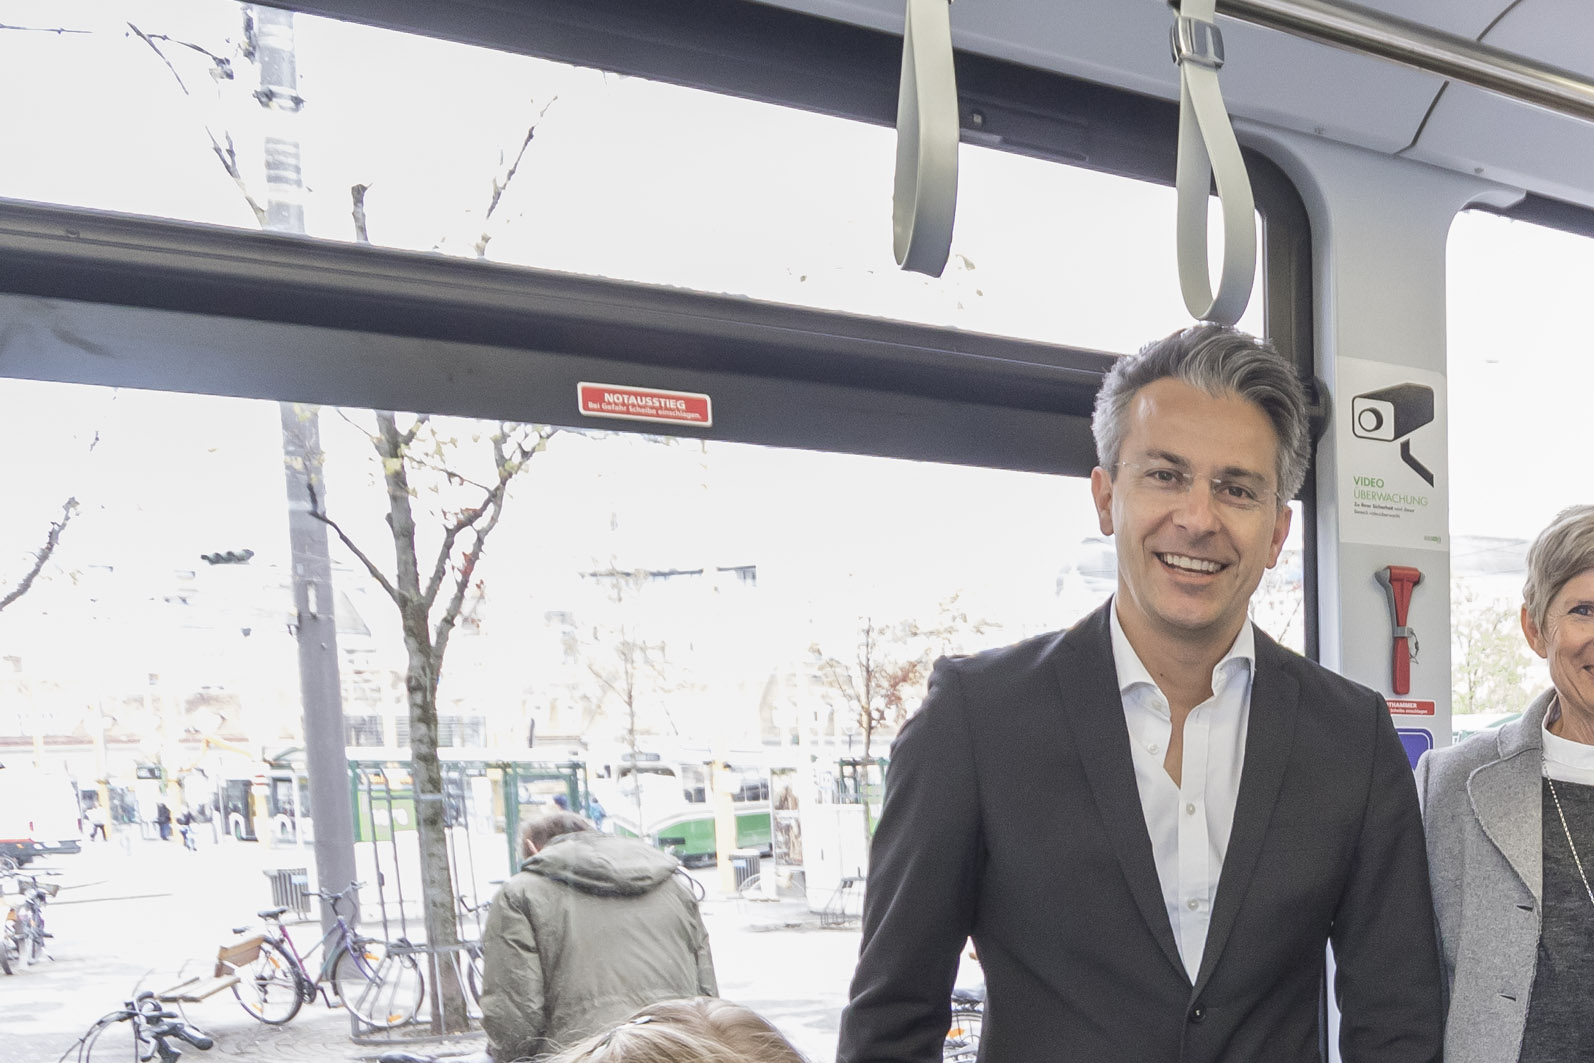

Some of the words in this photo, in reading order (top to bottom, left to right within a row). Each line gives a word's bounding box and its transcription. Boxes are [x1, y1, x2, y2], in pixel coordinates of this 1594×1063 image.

[601, 402, 627, 412] Gefahr
[629, 404, 656, 415] Scheibe
[604, 392, 686, 410] NOTAUSSTIEG
[1353, 476, 1385, 488] VIDEO
[1353, 487, 1429, 506] ÜBERWACHUNG
